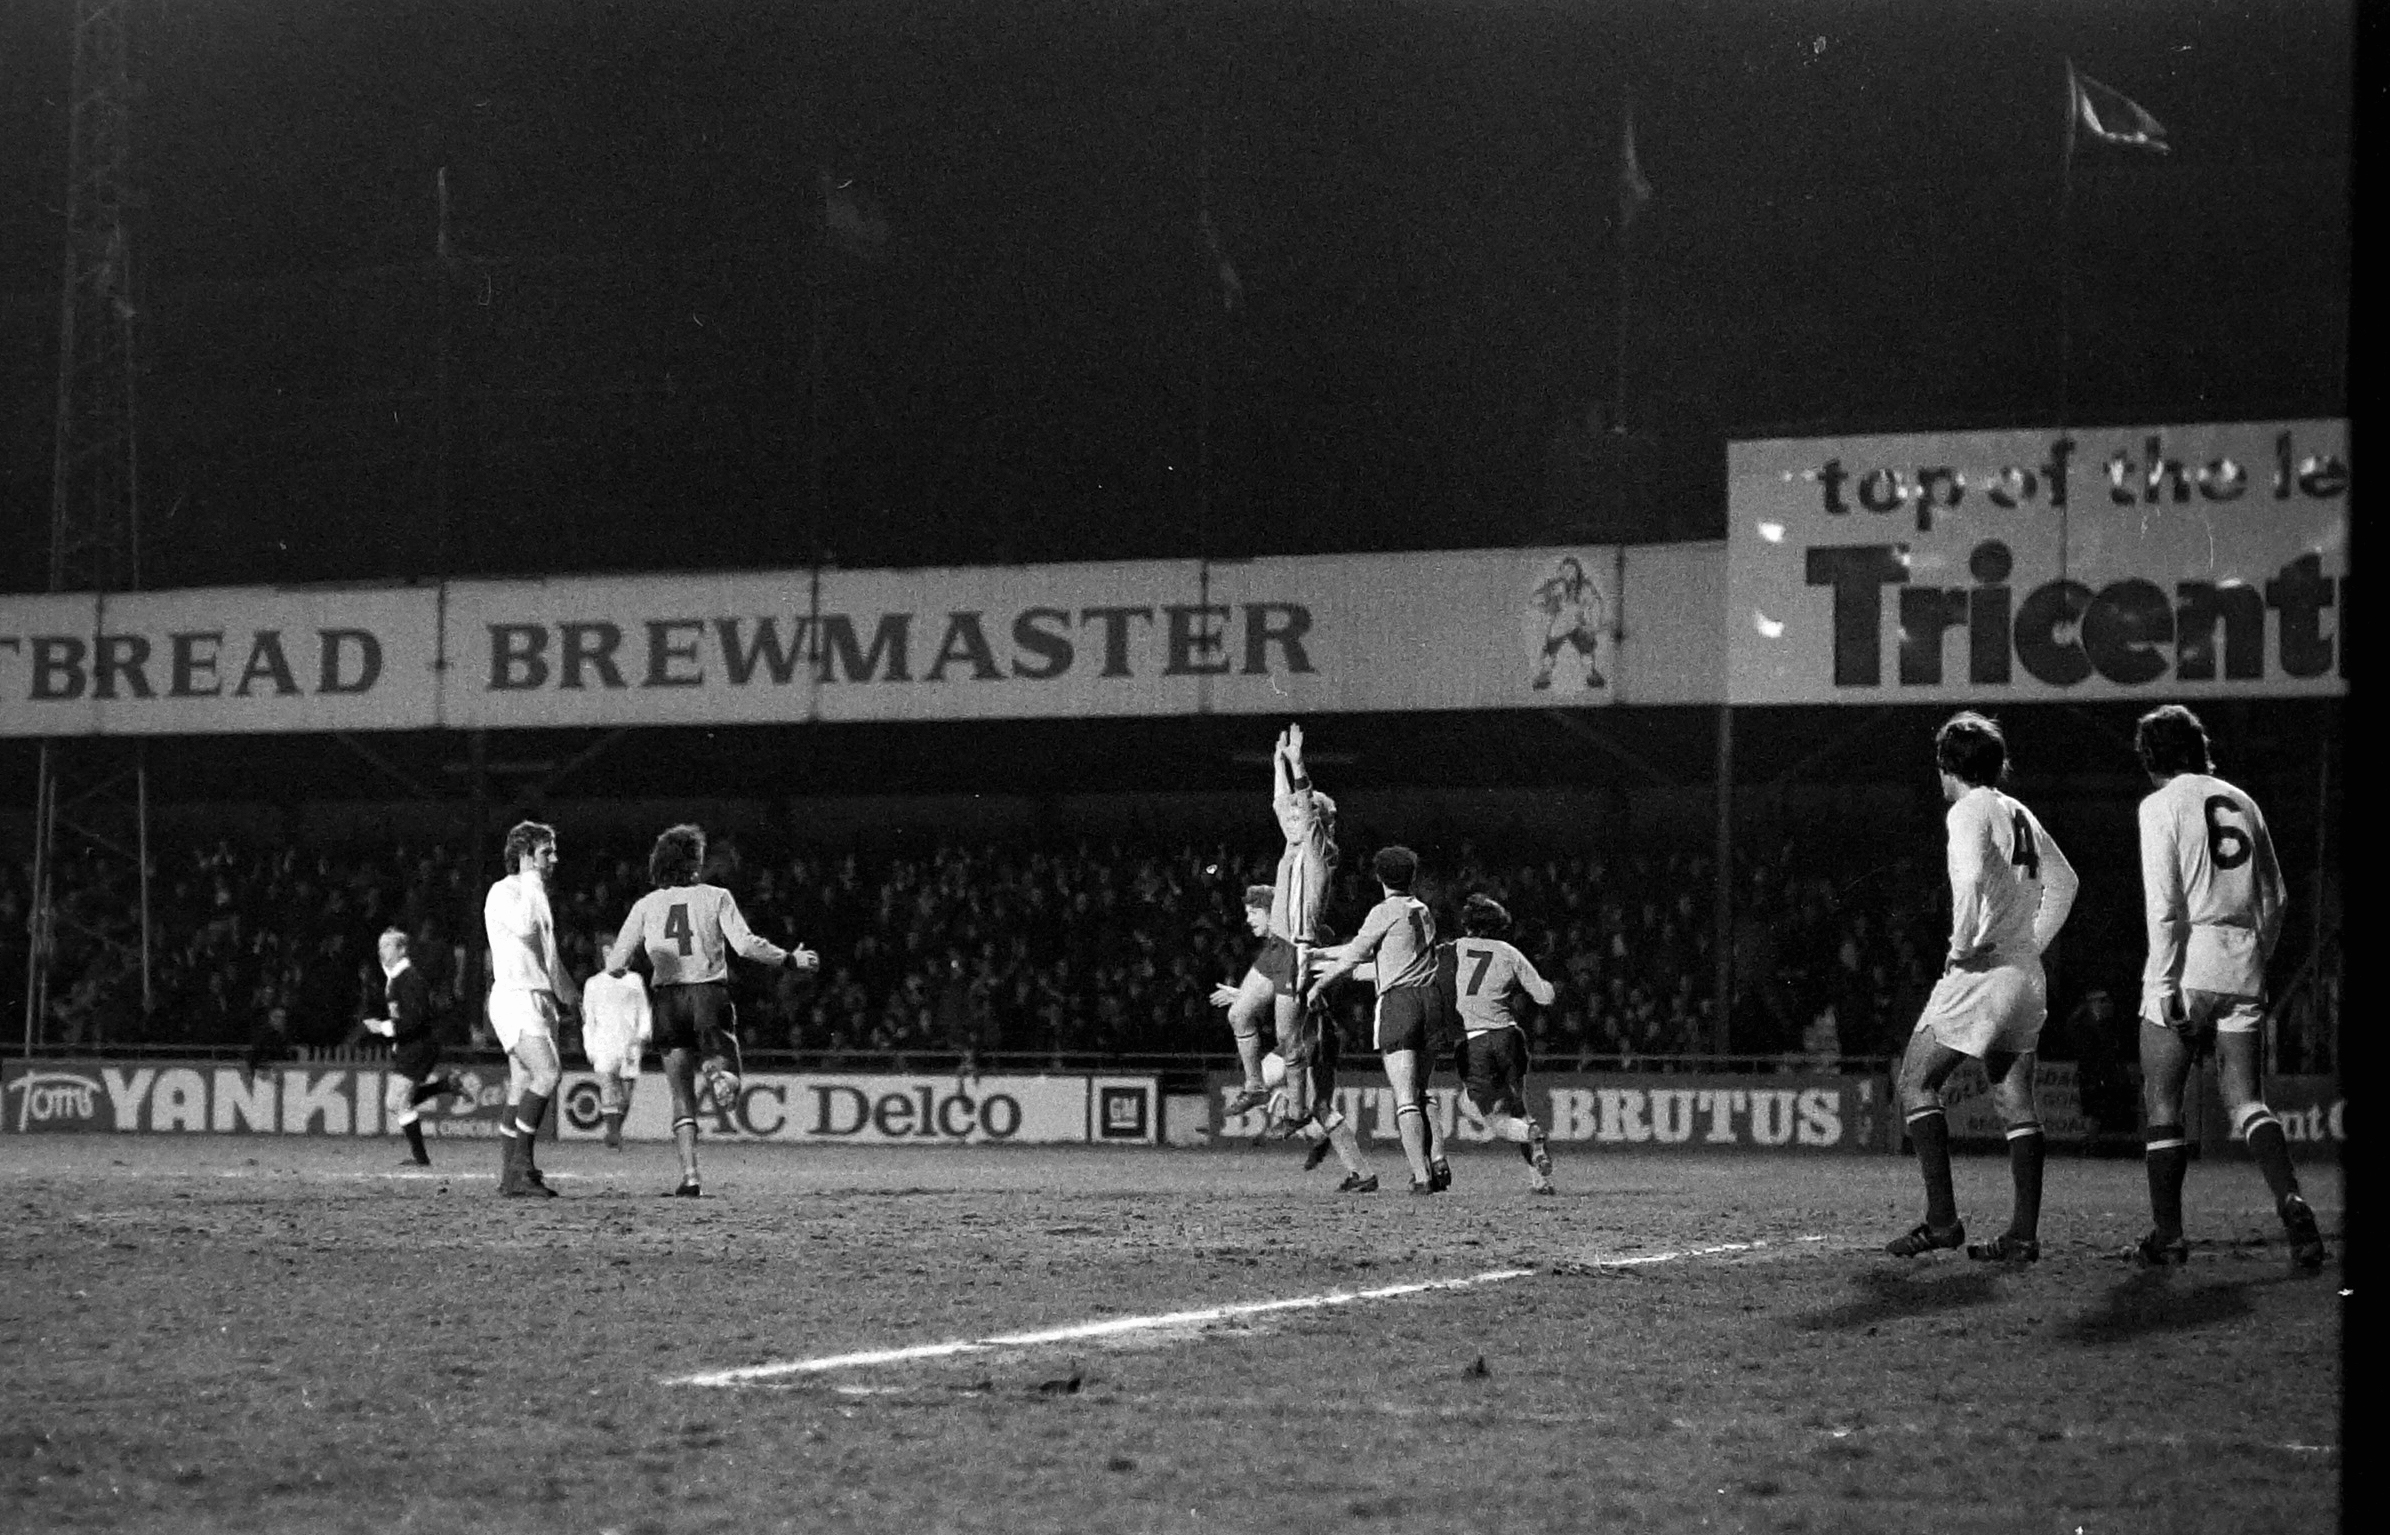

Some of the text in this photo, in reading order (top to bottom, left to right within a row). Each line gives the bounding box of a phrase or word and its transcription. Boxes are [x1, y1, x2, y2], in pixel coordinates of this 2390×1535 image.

[1817, 457, 1965, 532] top
[1987, 436, 2076, 509] of
[485, 601, 1319, 691] BREWMASTER
[1805, 538, 2347, 687] Tricent
[2011, 807, 2040, 880] 4
[2204, 794, 2252, 870] 6
[664, 902, 693, 957] 4
[1465, 948, 1494, 997] 7
[806, 1083, 1022, 1139] Delco
[1548, 1087, 1843, 1146] BRUTUS
